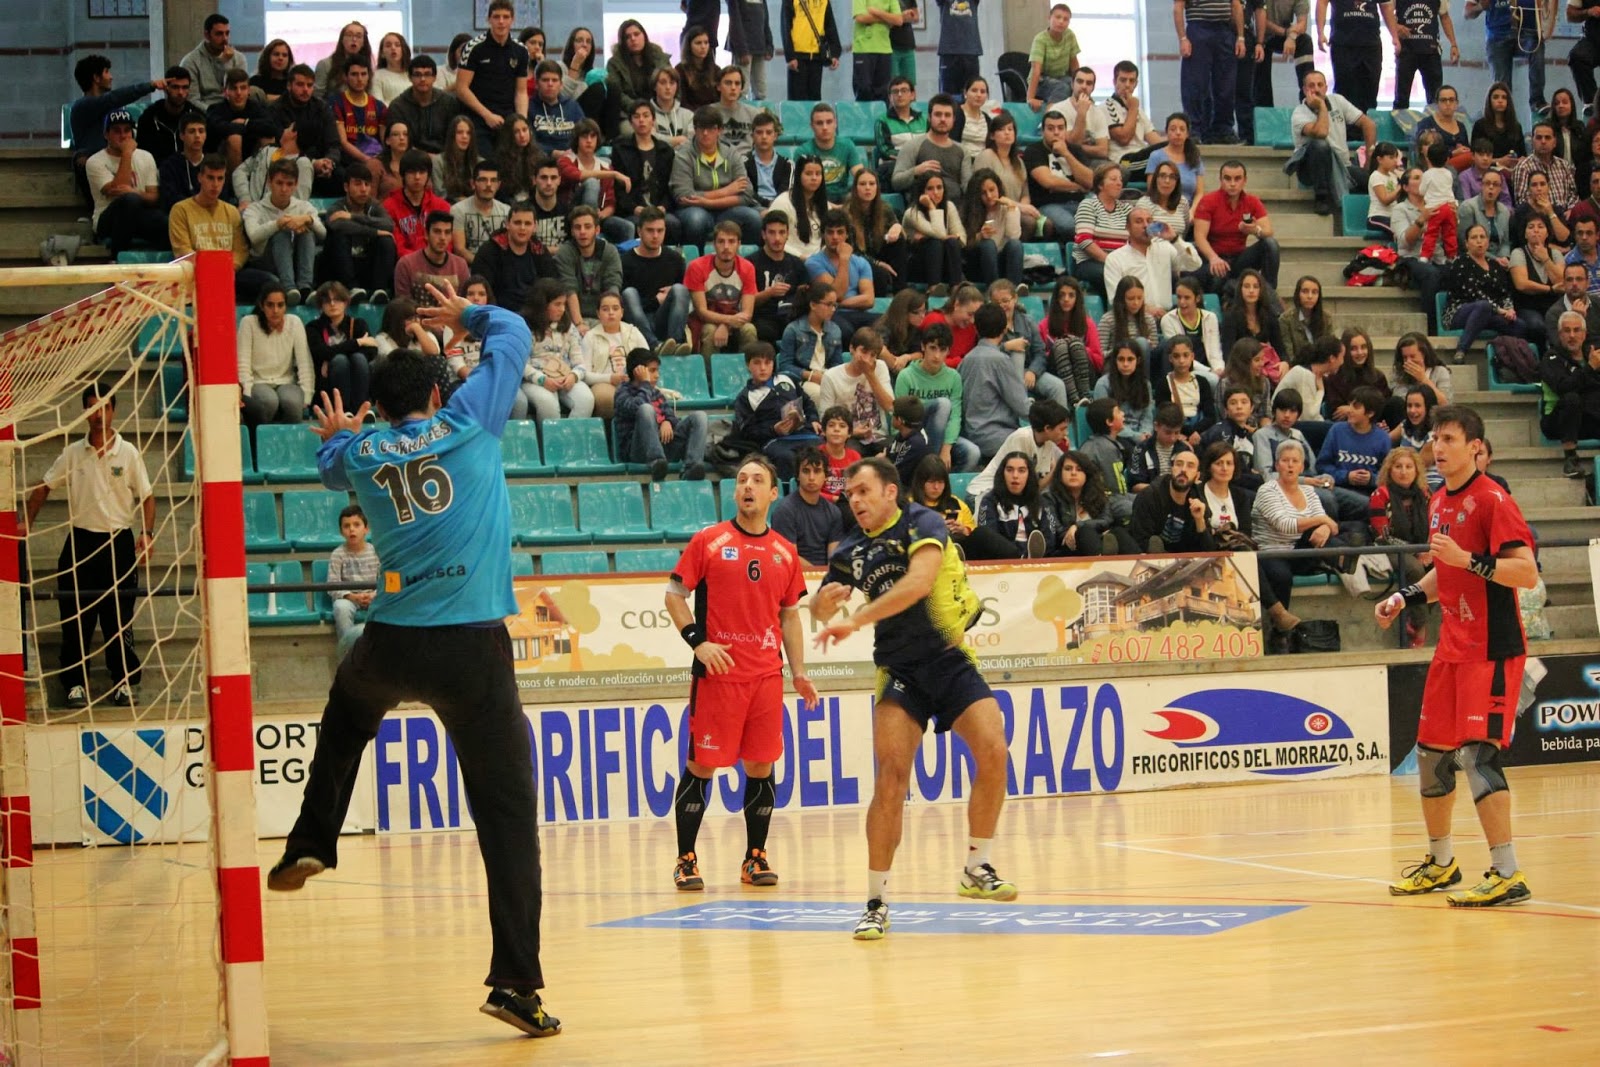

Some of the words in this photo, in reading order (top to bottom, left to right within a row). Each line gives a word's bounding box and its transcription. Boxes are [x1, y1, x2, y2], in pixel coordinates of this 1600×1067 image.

[372, 453, 454, 525] 16
[748, 559, 762, 582] 6
[852, 559, 865, 581] 8
[621, 609, 672, 629] cas
[1108, 636, 1152, 663] 607
[1160, 634, 1205, 661] 482
[1212, 631, 1261, 659] 405
[543, 676, 556, 687] de
[601, 672, 654, 685] realización
[657, 674, 663, 683] y
[807, 666, 854, 677] mobiliario
[1541, 736, 1583, 751] bebida
[1132, 749, 1240, 775] FRIGORIFICOS
[1244, 748, 1272, 768] DEL
[1275, 742, 1354, 766] MORRAZO,
[700, 906, 941, 916] MRRAZO
